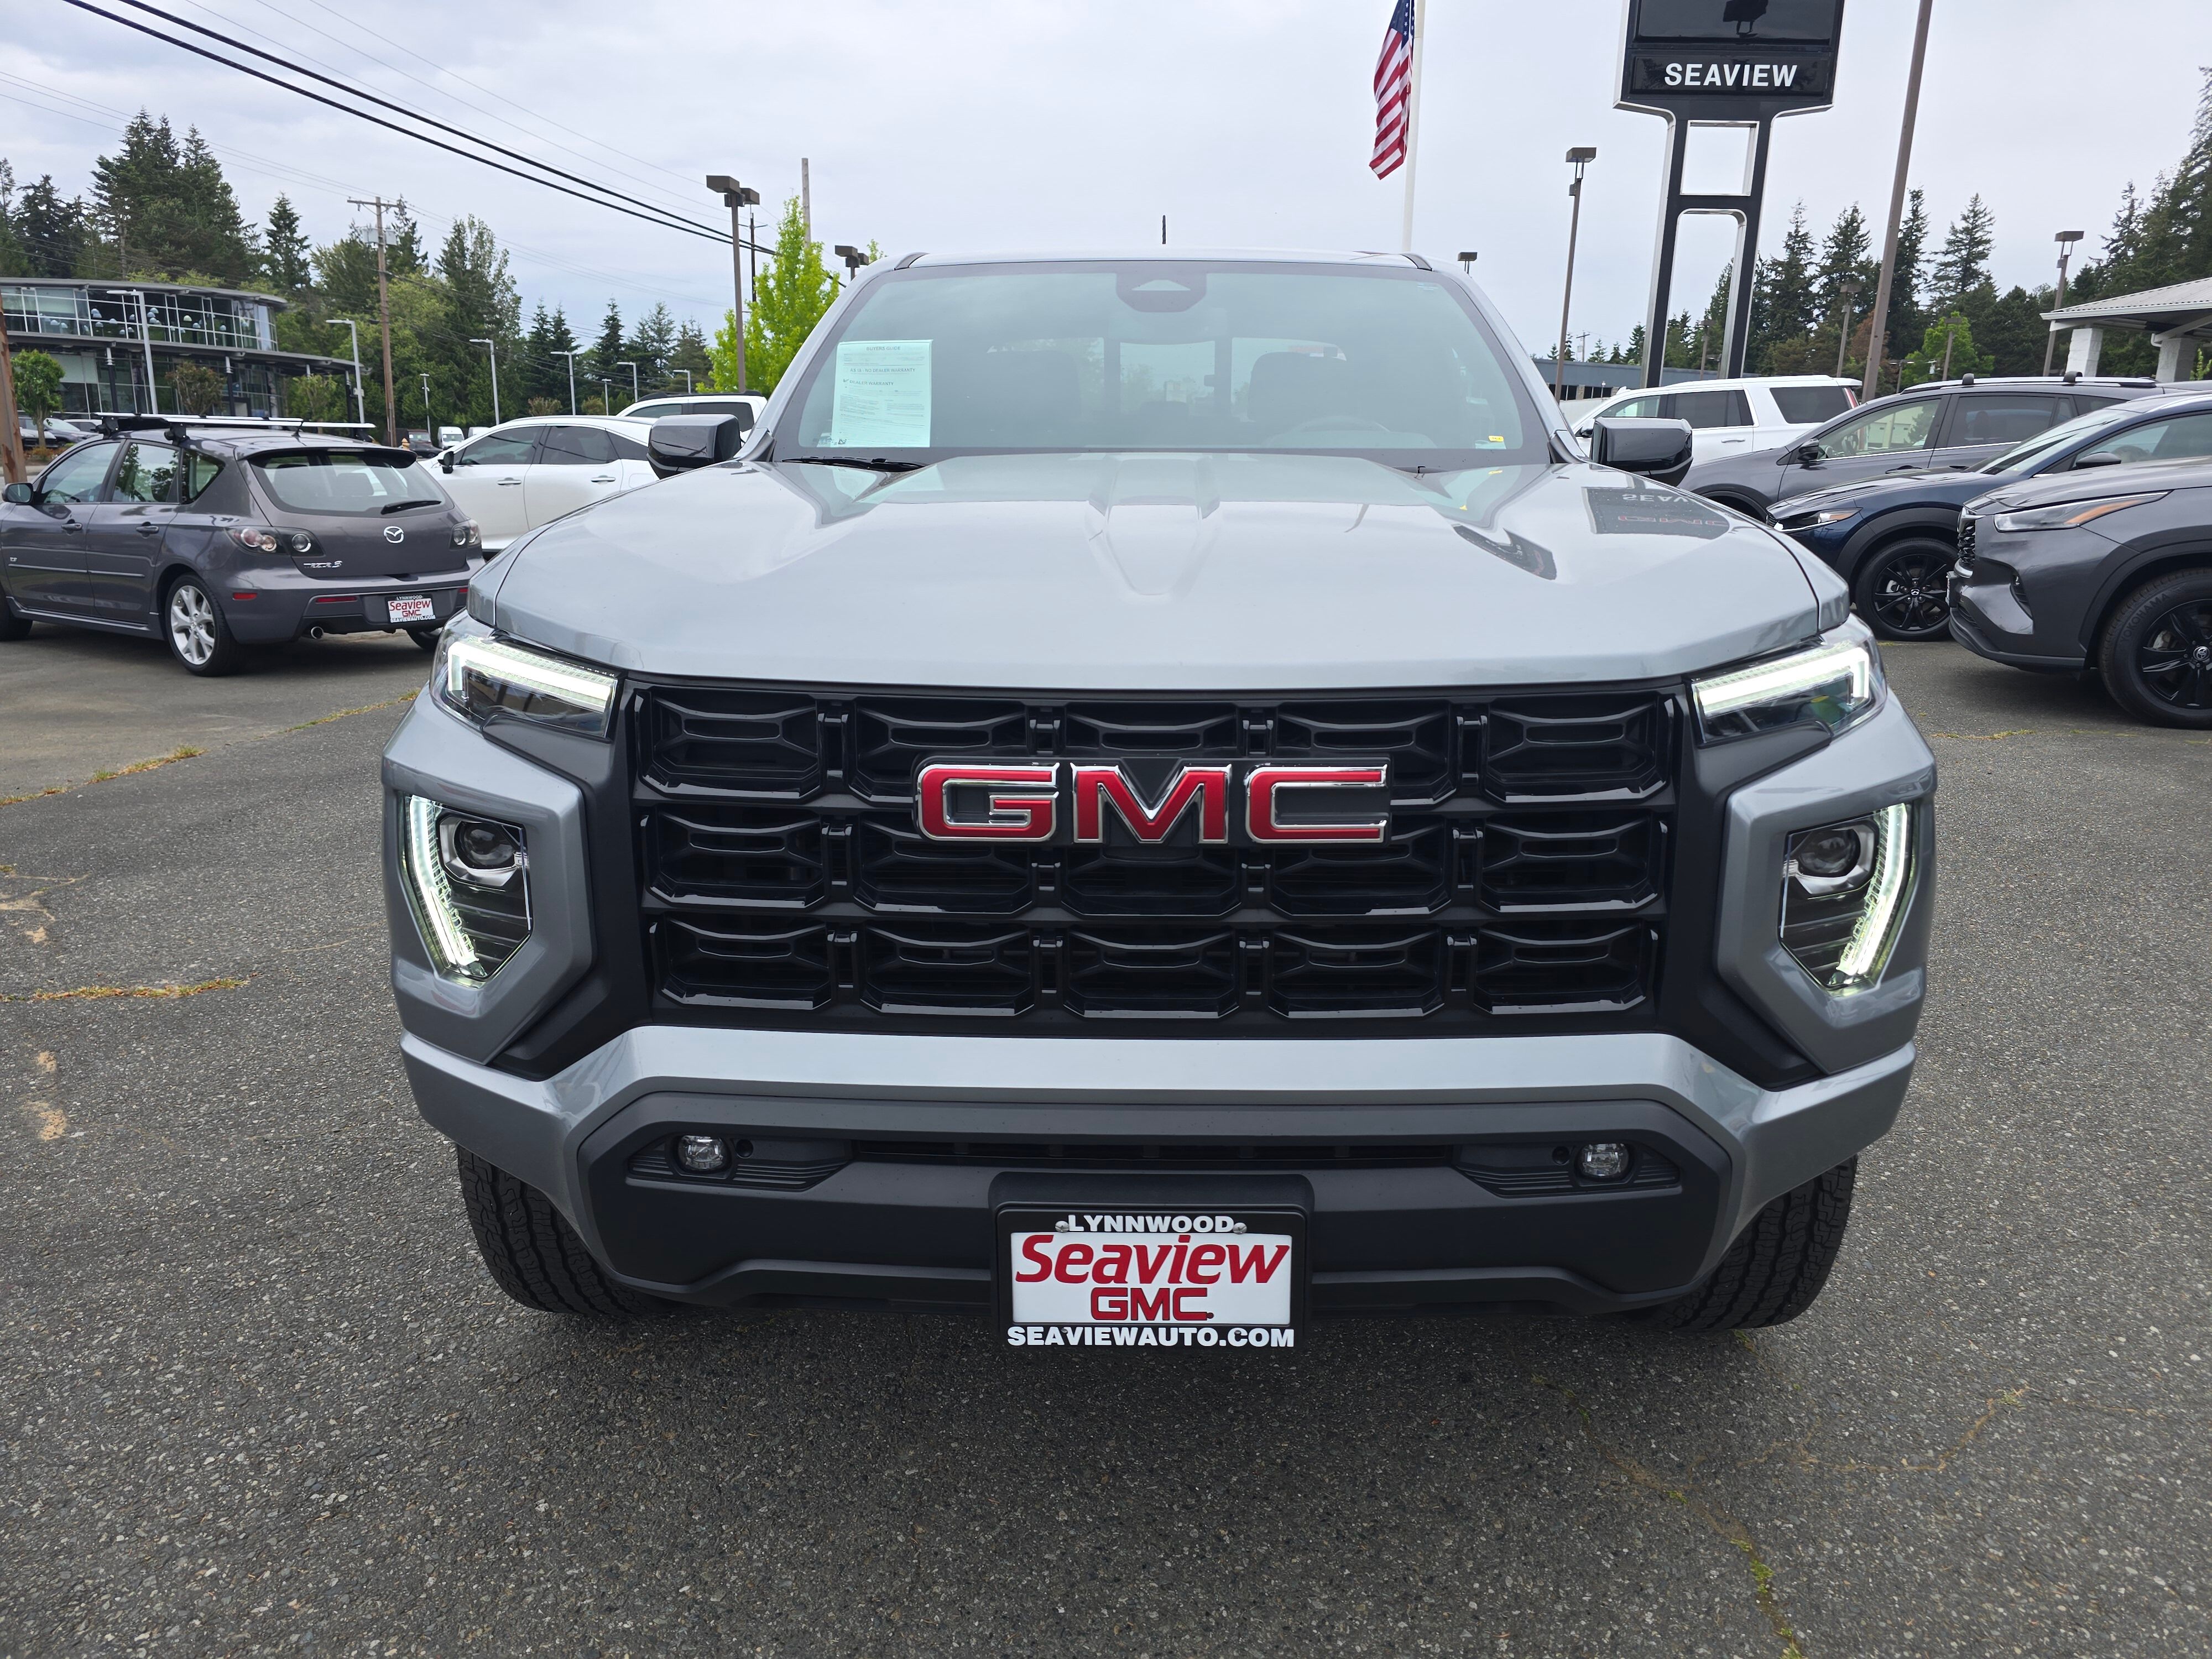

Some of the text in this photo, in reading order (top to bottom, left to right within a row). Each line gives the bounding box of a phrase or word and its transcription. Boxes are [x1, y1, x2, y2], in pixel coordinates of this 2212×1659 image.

[1664, 62, 1798, 87] SEAVIEW
[389, 600, 431, 611] Seaview
[2120, 592, 2171, 643] YOKOHAMA
[917, 762, 1388, 844] GMC
[1068, 1214, 1234, 1233] LYNNWOOD
[1015, 1234, 1291, 1284] Seaview
[1091, 1287, 1208, 1321] GMC
[1007, 1326, 1295, 1348] SEAVIEWAUTO.COM
